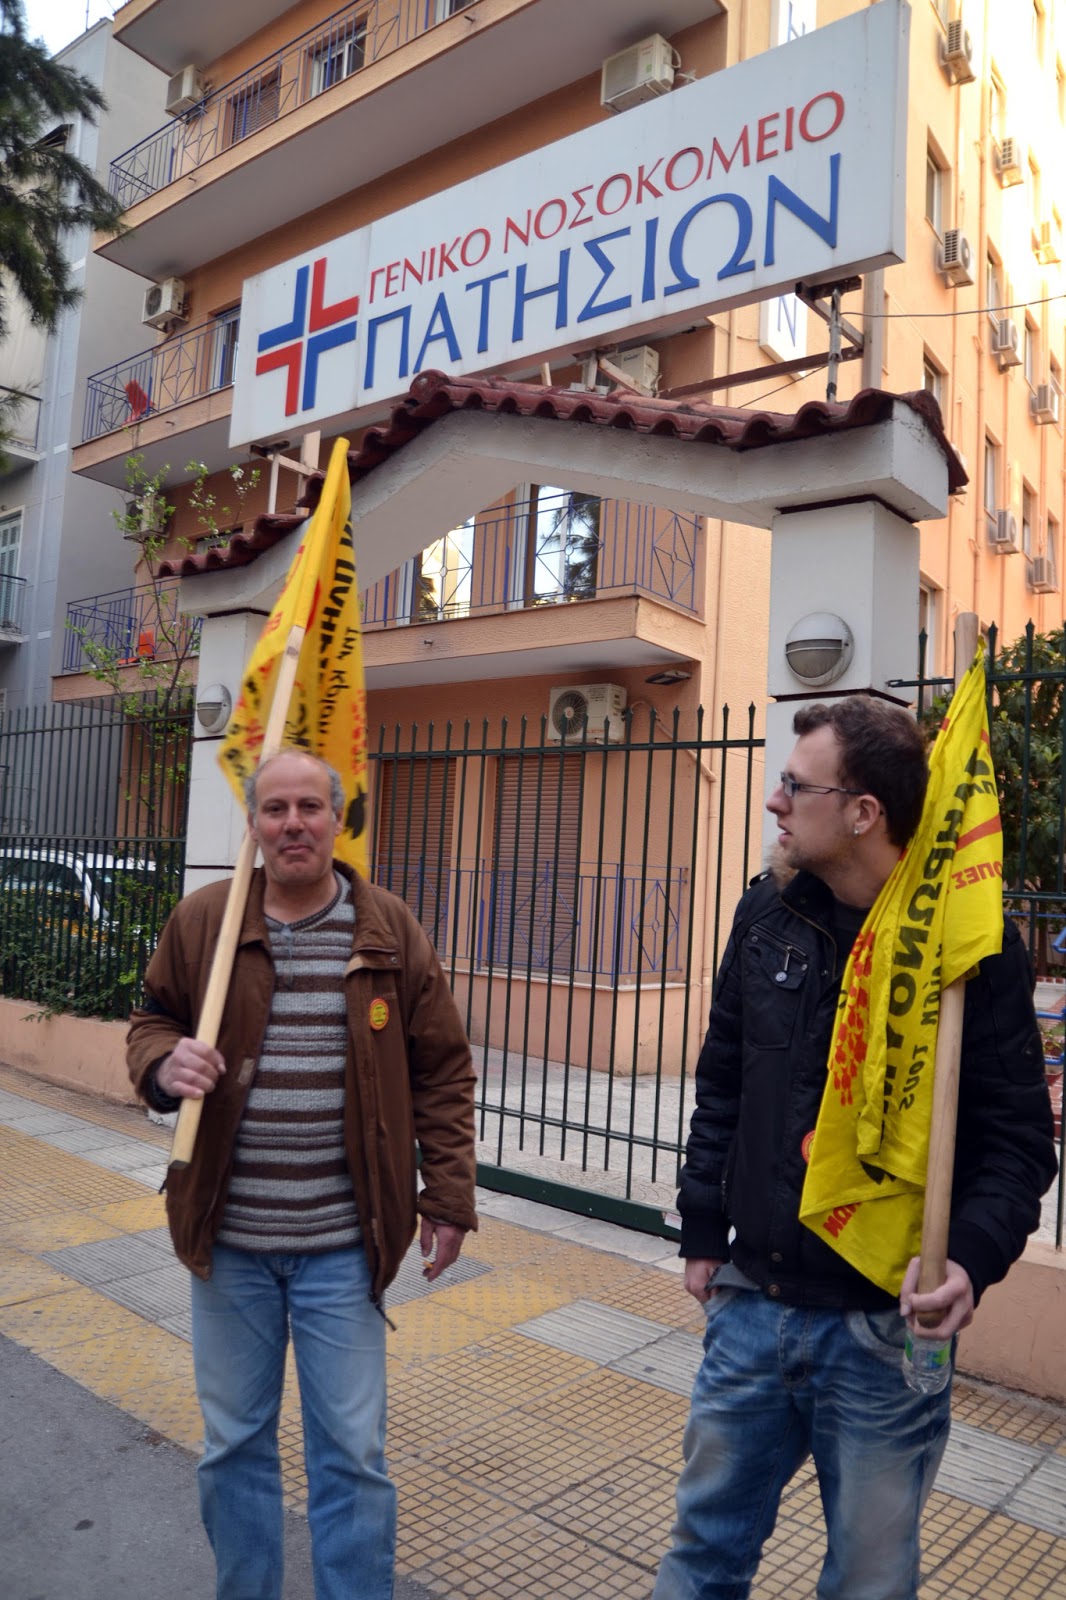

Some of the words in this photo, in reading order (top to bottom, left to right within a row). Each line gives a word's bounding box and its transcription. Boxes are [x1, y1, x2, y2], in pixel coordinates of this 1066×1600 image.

[363, 152, 841, 390] ΠΑΤΗΣΙΩΝ
[369, 227, 492, 304] ΓΕΝΙΚΟ
[503, 91, 845, 254] ΝΟΣΟΚΟΜΕΙΟ
